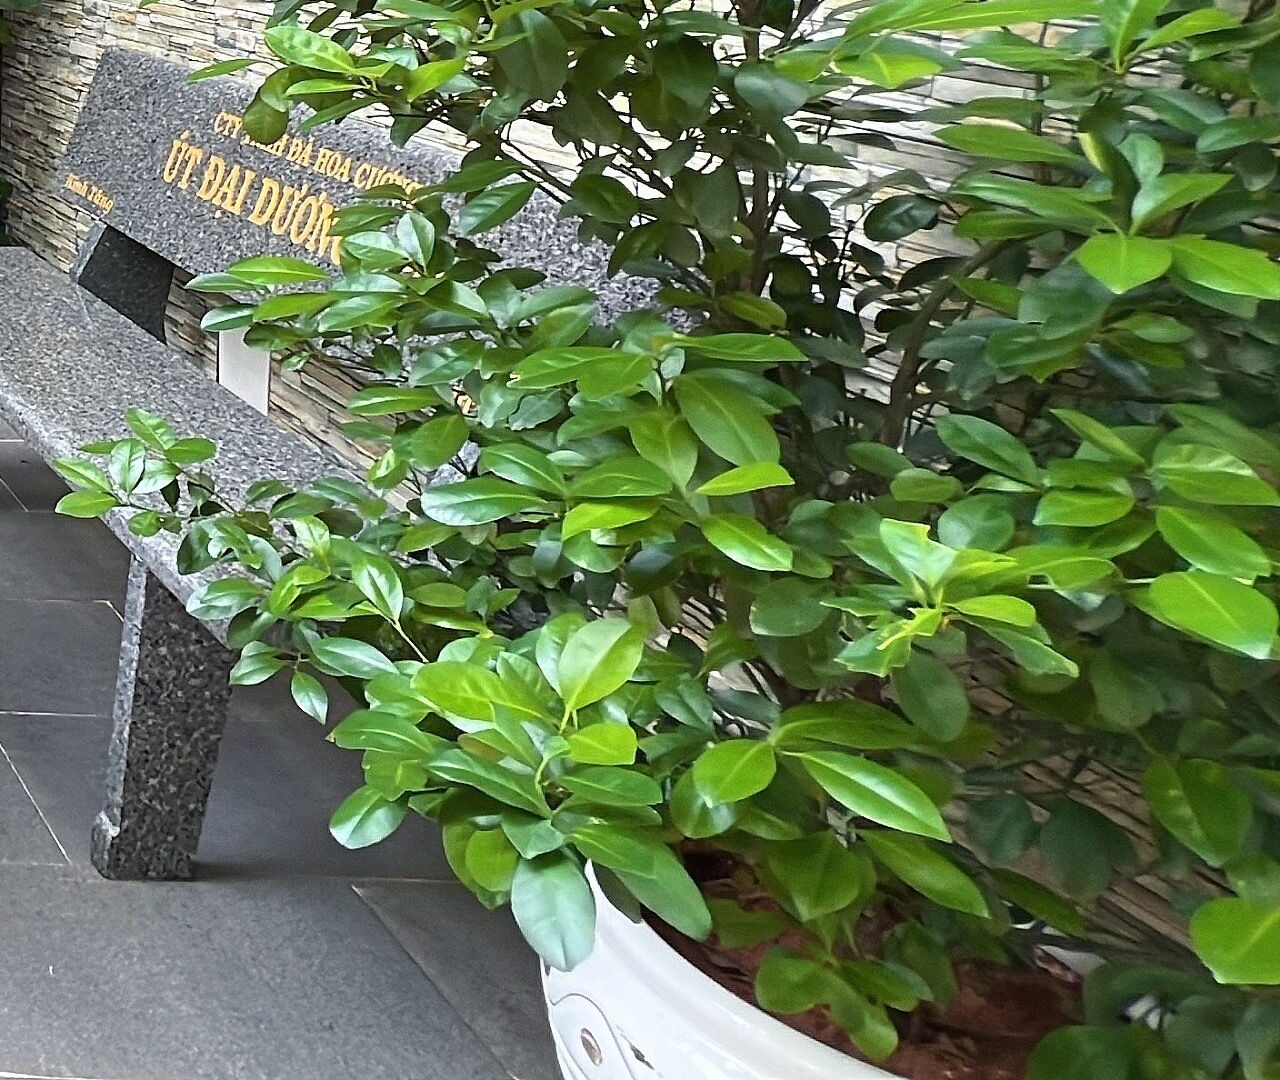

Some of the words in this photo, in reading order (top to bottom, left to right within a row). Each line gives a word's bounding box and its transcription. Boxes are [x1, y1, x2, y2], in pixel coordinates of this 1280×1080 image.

[163, 129, 204, 190] ÚT
[196, 155, 256, 218] ĐẠI
[214, 110, 244, 139] CTY
[288, 135, 315, 167] ĐÁ
[313, 147, 350, 183] HOA
